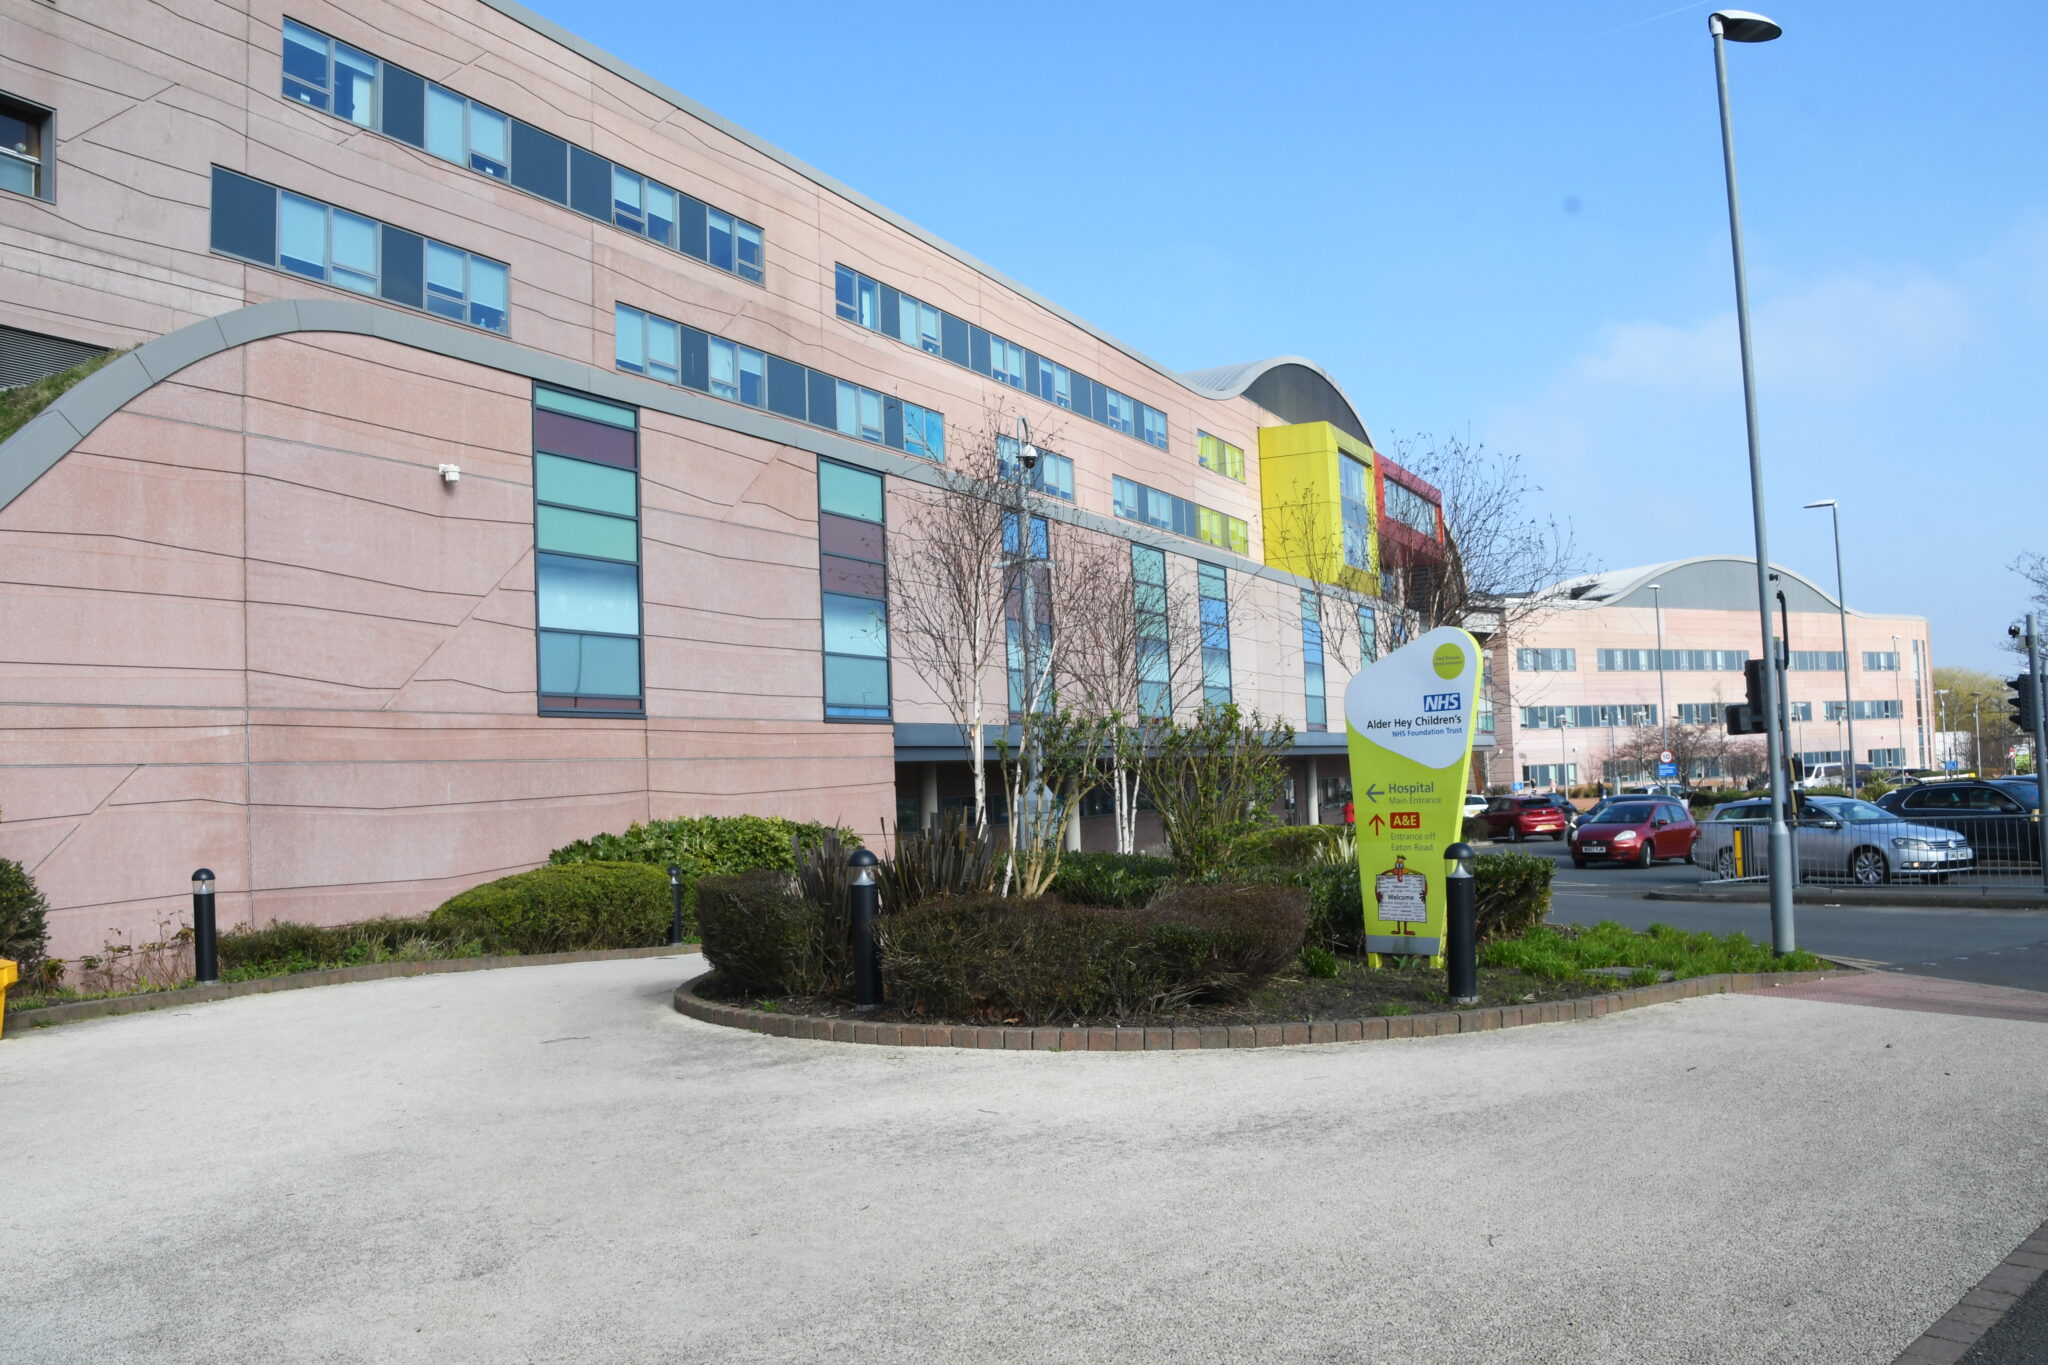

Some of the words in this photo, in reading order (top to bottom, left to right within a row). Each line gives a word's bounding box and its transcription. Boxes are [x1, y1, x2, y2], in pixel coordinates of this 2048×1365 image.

[1425, 693, 1459, 711] NHS
[1366, 719, 1391, 729] Alder
[1394, 718, 1412, 729] Hey
[1415, 715, 1462, 726] Children's
[1407, 728, 1444, 736] Foundation
[1389, 782, 1434, 796] Hospital
[1393, 815, 1417, 826] A&E
[1390, 832, 1423, 840] Entrance
[1424, 832, 1436, 840] off
[1391, 843, 1412, 851] Eaton
[1414, 843, 1433, 851] Road
